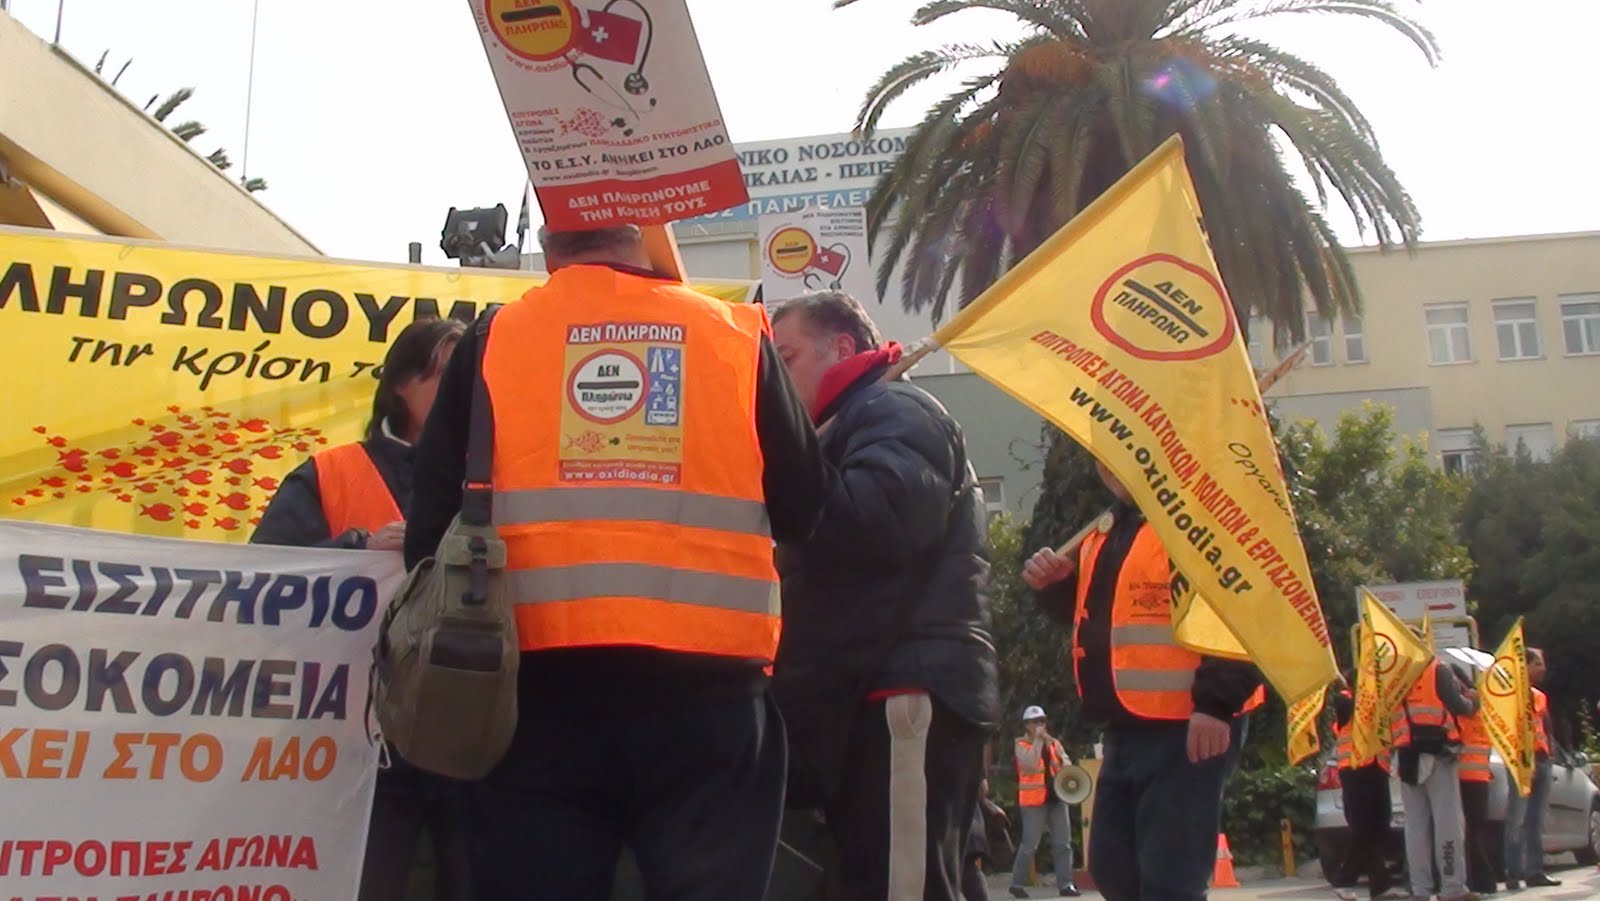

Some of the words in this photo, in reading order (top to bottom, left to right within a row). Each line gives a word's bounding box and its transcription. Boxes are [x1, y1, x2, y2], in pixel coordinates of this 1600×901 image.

[531, 160, 551, 171] ΤΟ
[656, 144, 689, 159] ΣΤΟ
[693, 134, 725, 152] ΛΑΟ
[568, 196, 600, 209] ΔΕΝ
[603, 180, 712, 204] ΠΛΗΡΩΝΟΥΜΕ
[580, 209, 614, 222] ΤΗΝ
[618, 204, 661, 219] ΚΡΙΣΗ
[663, 197, 708, 216] ΤΟΥΣ
[0, 262, 500, 343] ΛΗΡΩΝΟΥ
[1112, 291, 1190, 344] ΠΛΗΡΩΝΩ
[1154, 281, 1203, 315] ΔΕΝ
[569, 326, 601, 342] ΔΕΝ
[605, 324, 683, 342] ΠΛΗΡΩΝΩ
[172, 340, 332, 391] κρίση
[597, 365, 620, 377] ΔΕΝ
[1030, 330, 1110, 378] ΕΠΙΤΡΟΠΕΣ
[1097, 368, 1150, 413] ΑΓΩΝΑ
[1191, 472, 1251, 535] ΠΟΛΙΤΩΝ
[1236, 527, 1260, 547] &
[565, 469, 675, 483] www.oxidiodia.gr
[1069, 386, 1253, 595] www.oxidiodia.gr
[19, 554, 378, 631] ΕΙΣΙΤΗΡΙΟ
[102, 733, 223, 782] ΣΤΟ
[241, 735, 338, 782] ΛΑΟ
[0, 839, 192, 877] ΙΤΡΟΠΕΣ
[195, 834, 319, 870] ΑΓΩΝΑ
